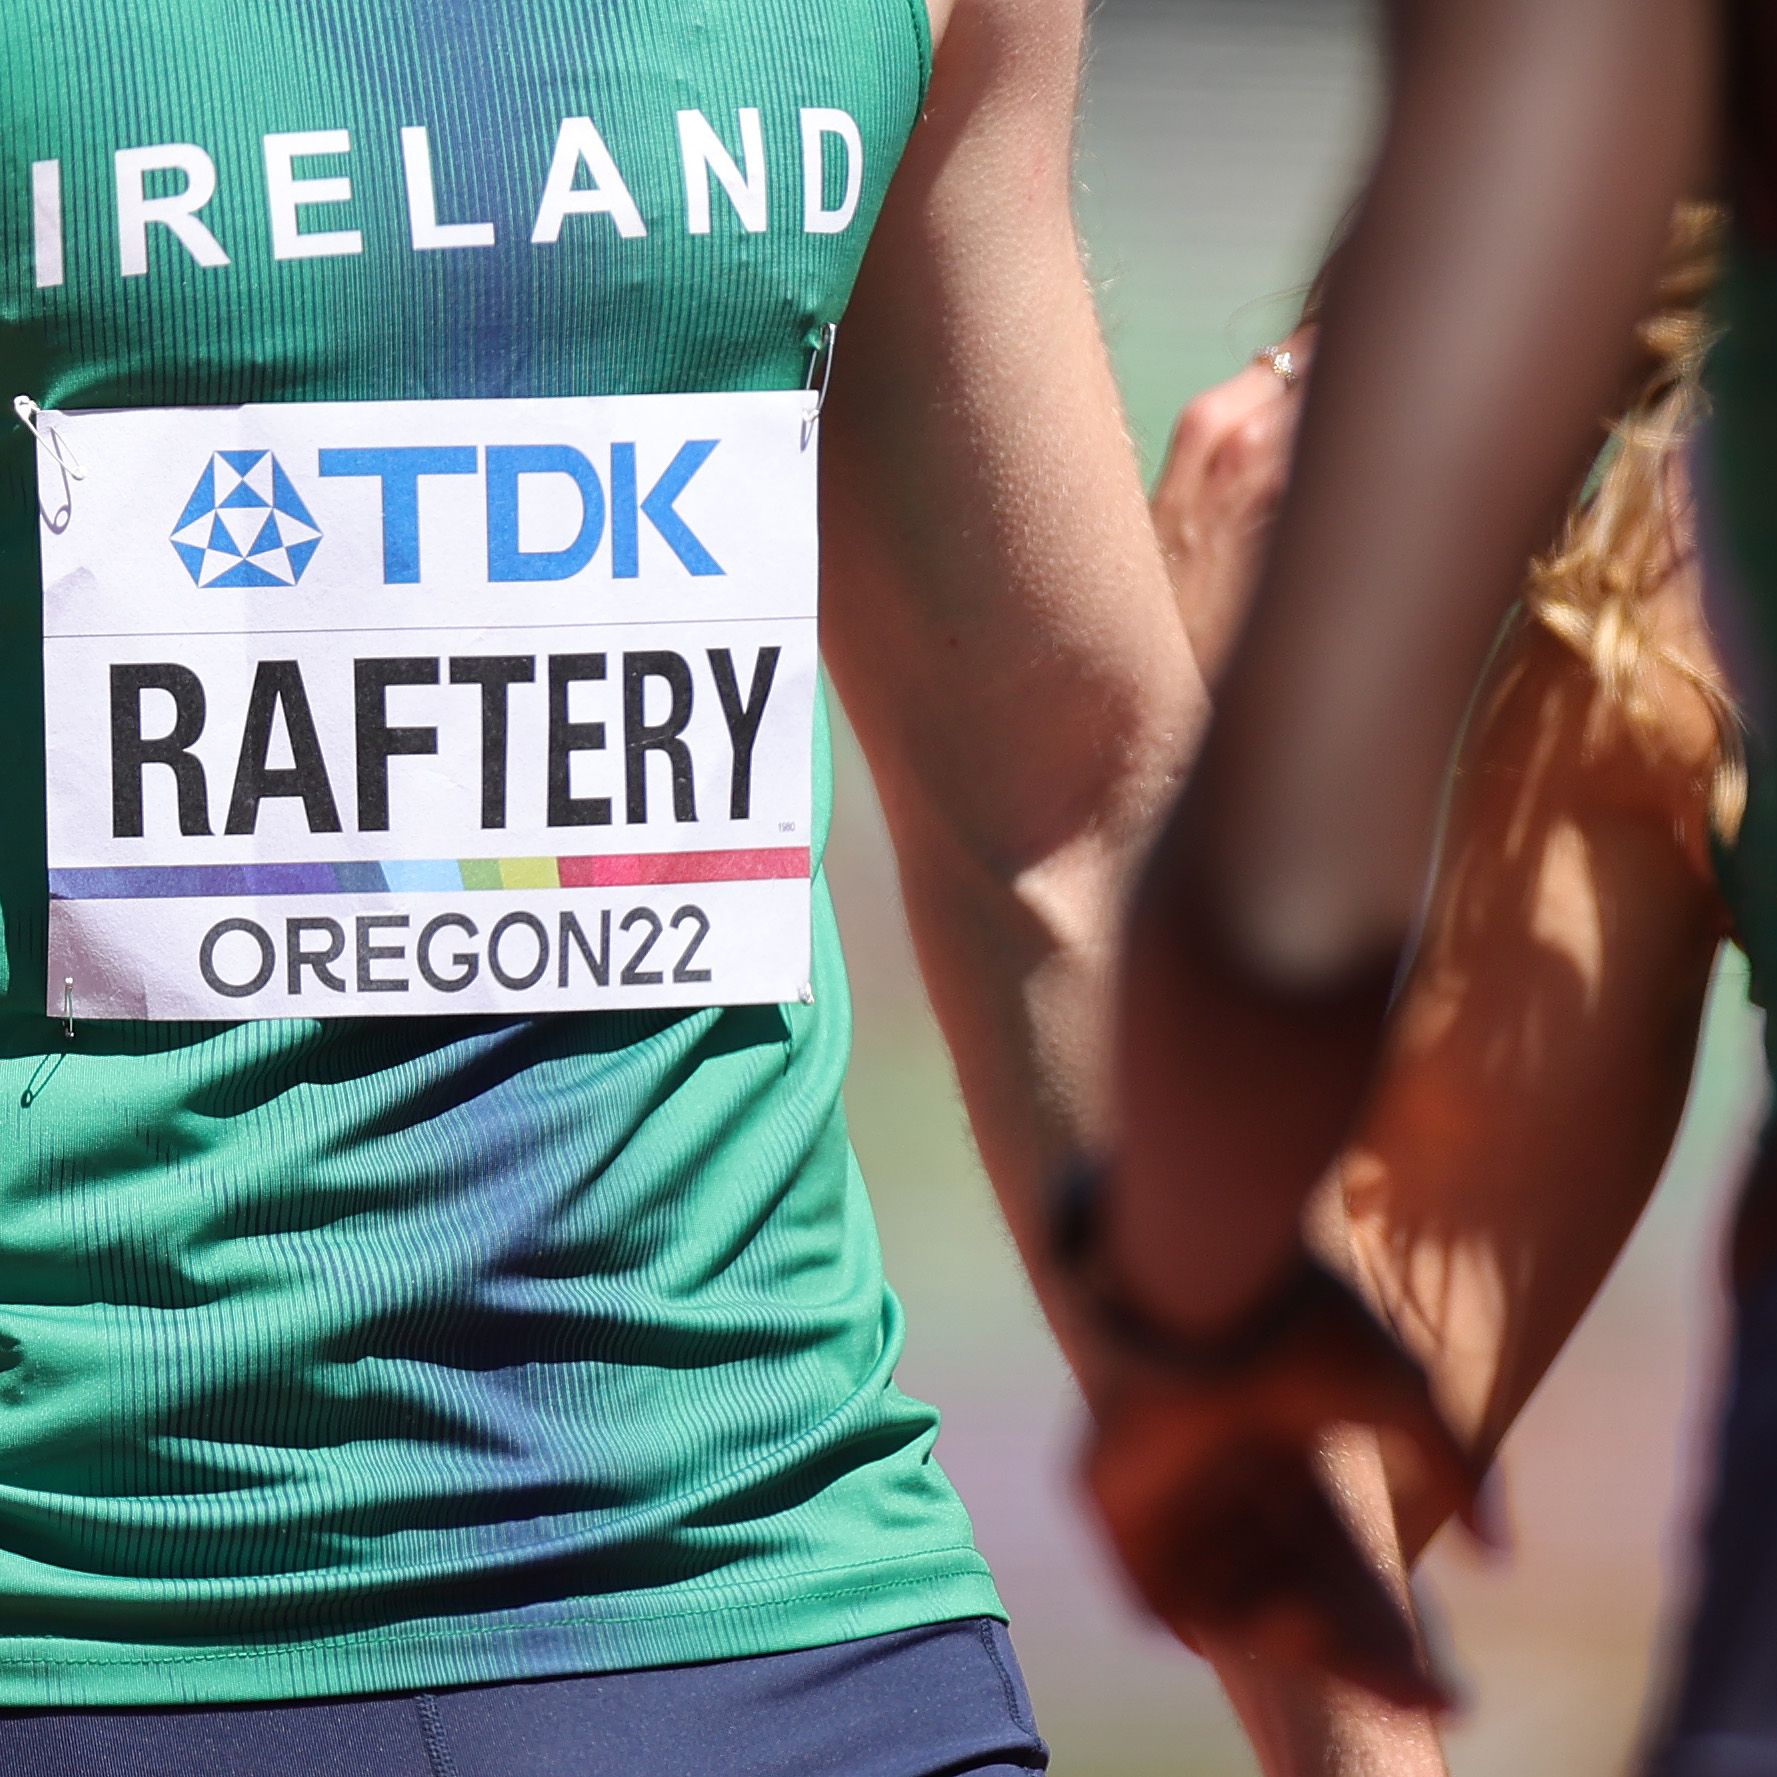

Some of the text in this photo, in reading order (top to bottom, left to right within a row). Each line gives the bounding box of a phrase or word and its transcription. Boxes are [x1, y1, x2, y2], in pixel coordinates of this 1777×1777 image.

[31, 106, 864, 289] IRELAND
[318, 438, 726, 585] TDK
[109, 646, 782, 839] RAFTERY
[198, 903, 713, 998] OREGON22
